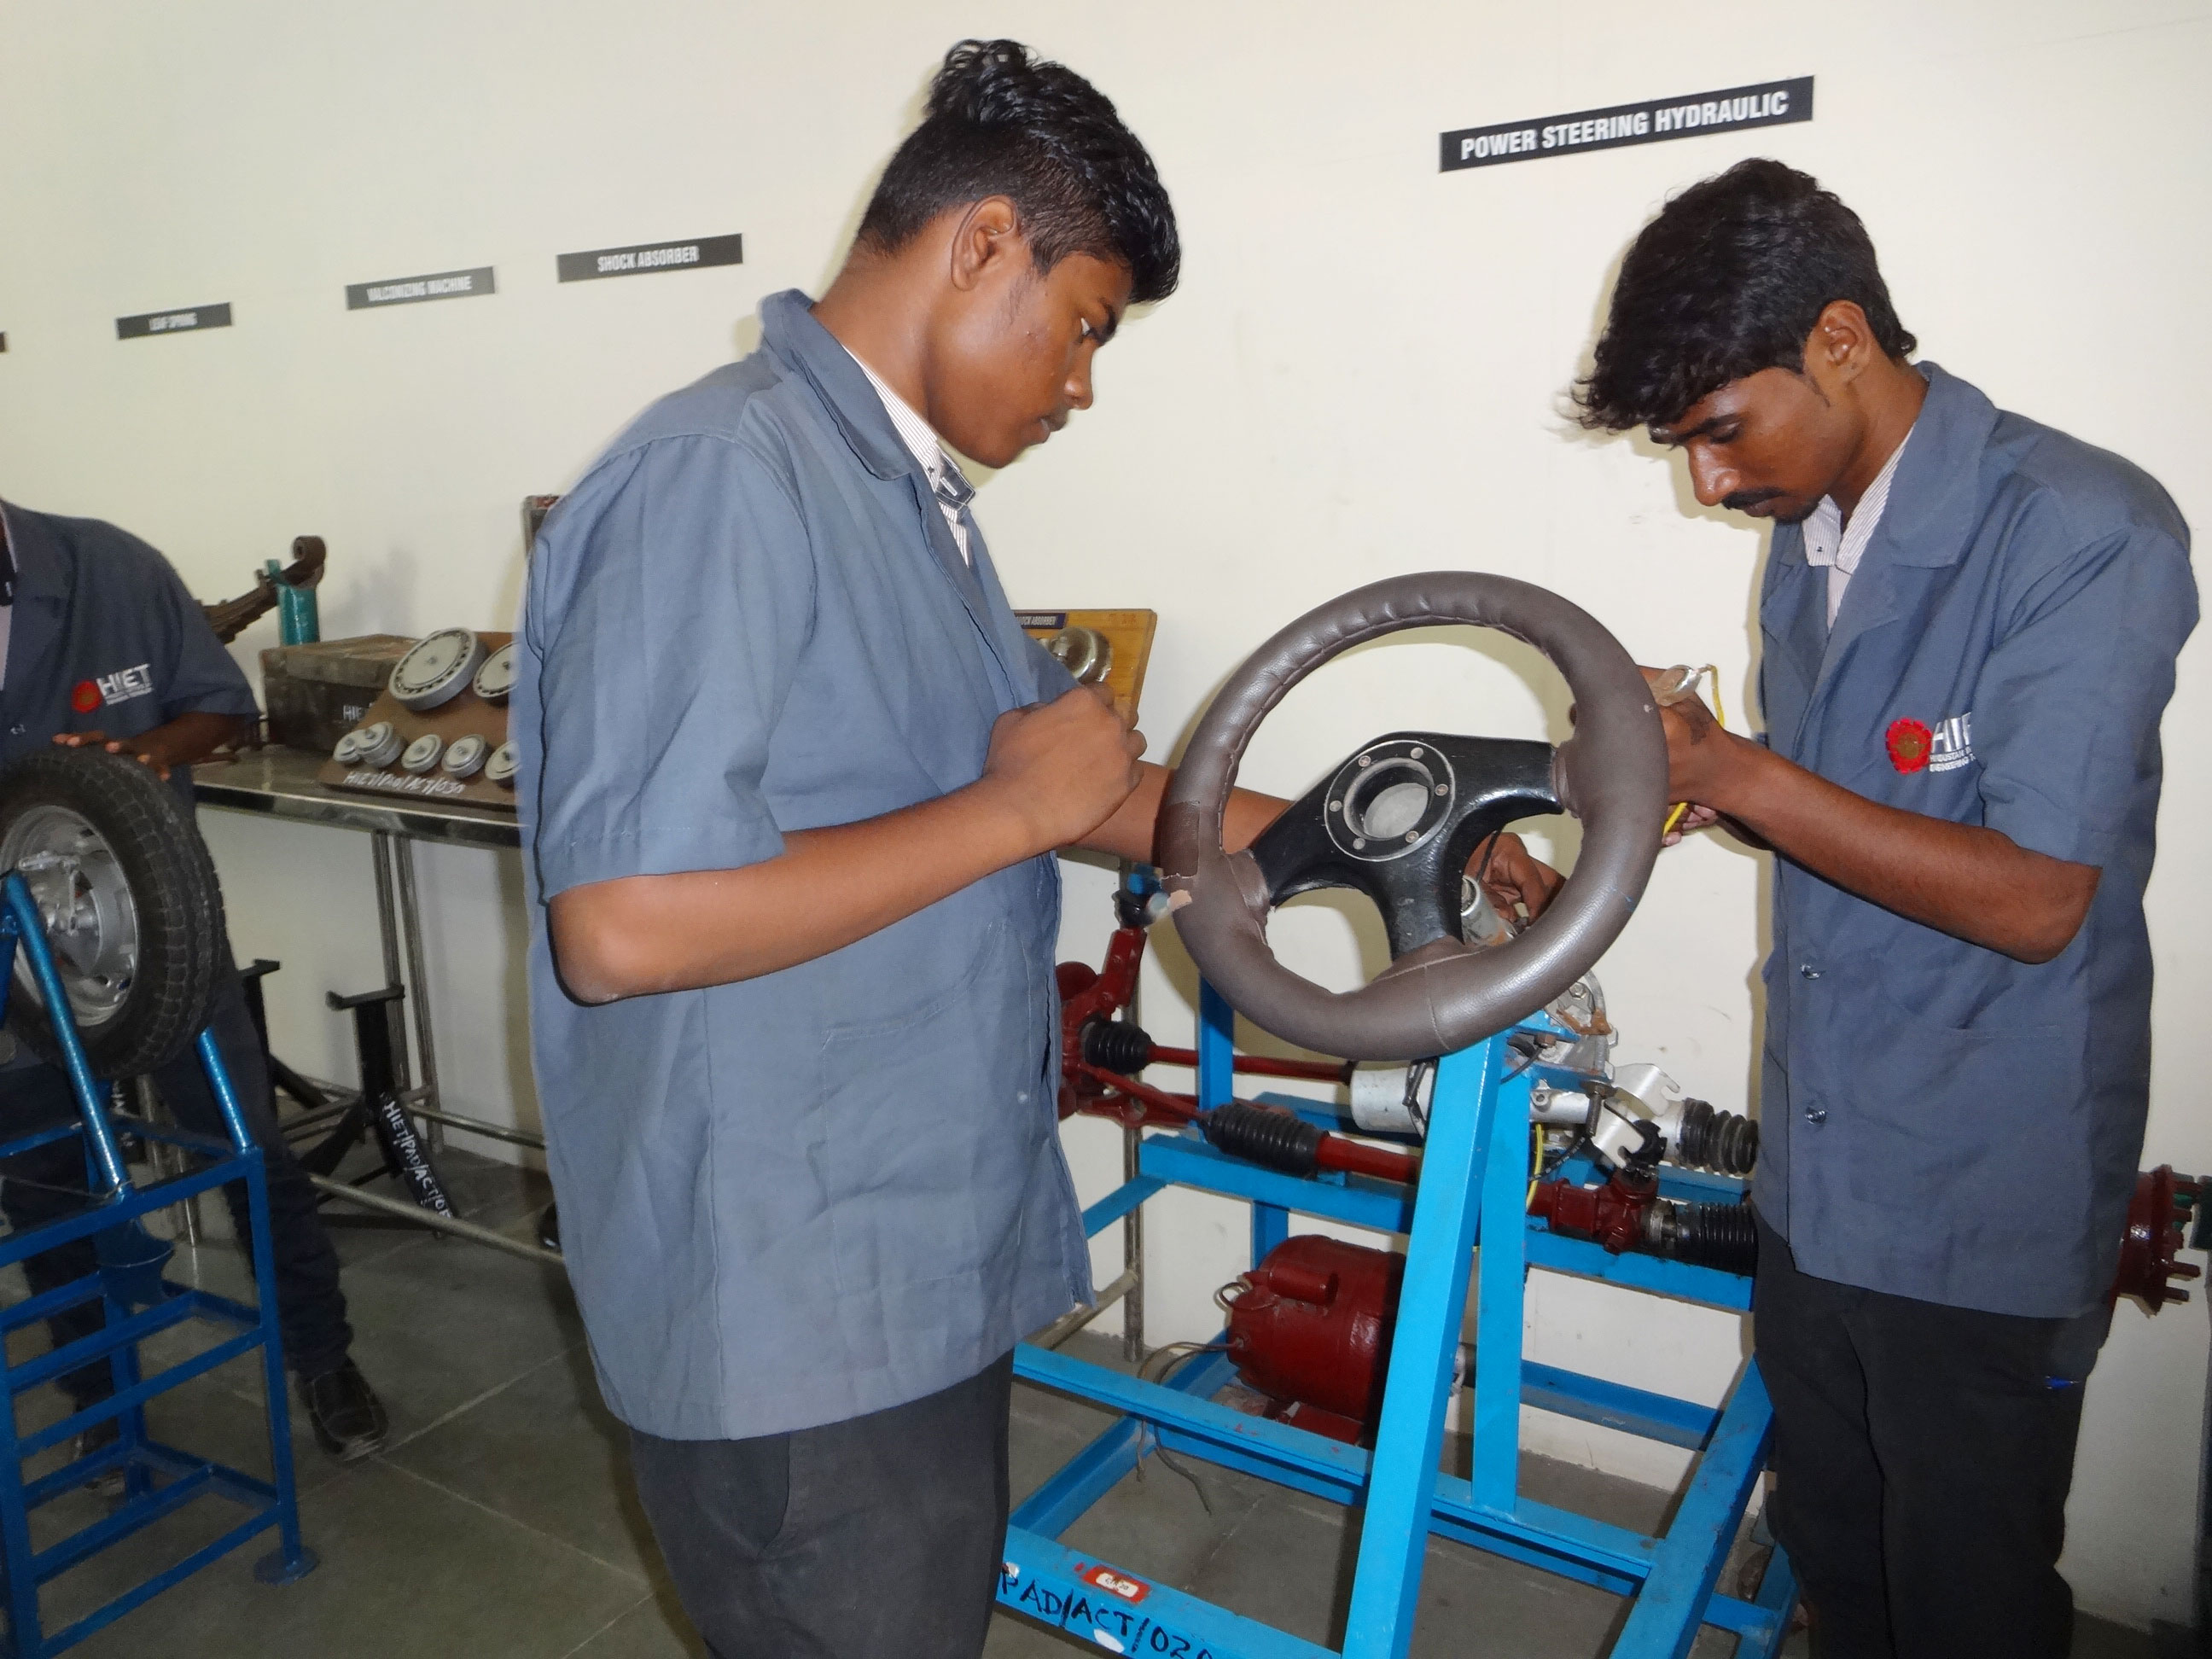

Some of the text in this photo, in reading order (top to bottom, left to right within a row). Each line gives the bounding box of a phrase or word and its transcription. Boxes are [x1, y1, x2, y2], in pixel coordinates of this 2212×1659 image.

[1460, 90, 1789, 160] POWER STEERING HYDRAULIC
[597, 246, 700, 272] SHOCK ABSORBER
[96, 663, 151, 696] HIET
